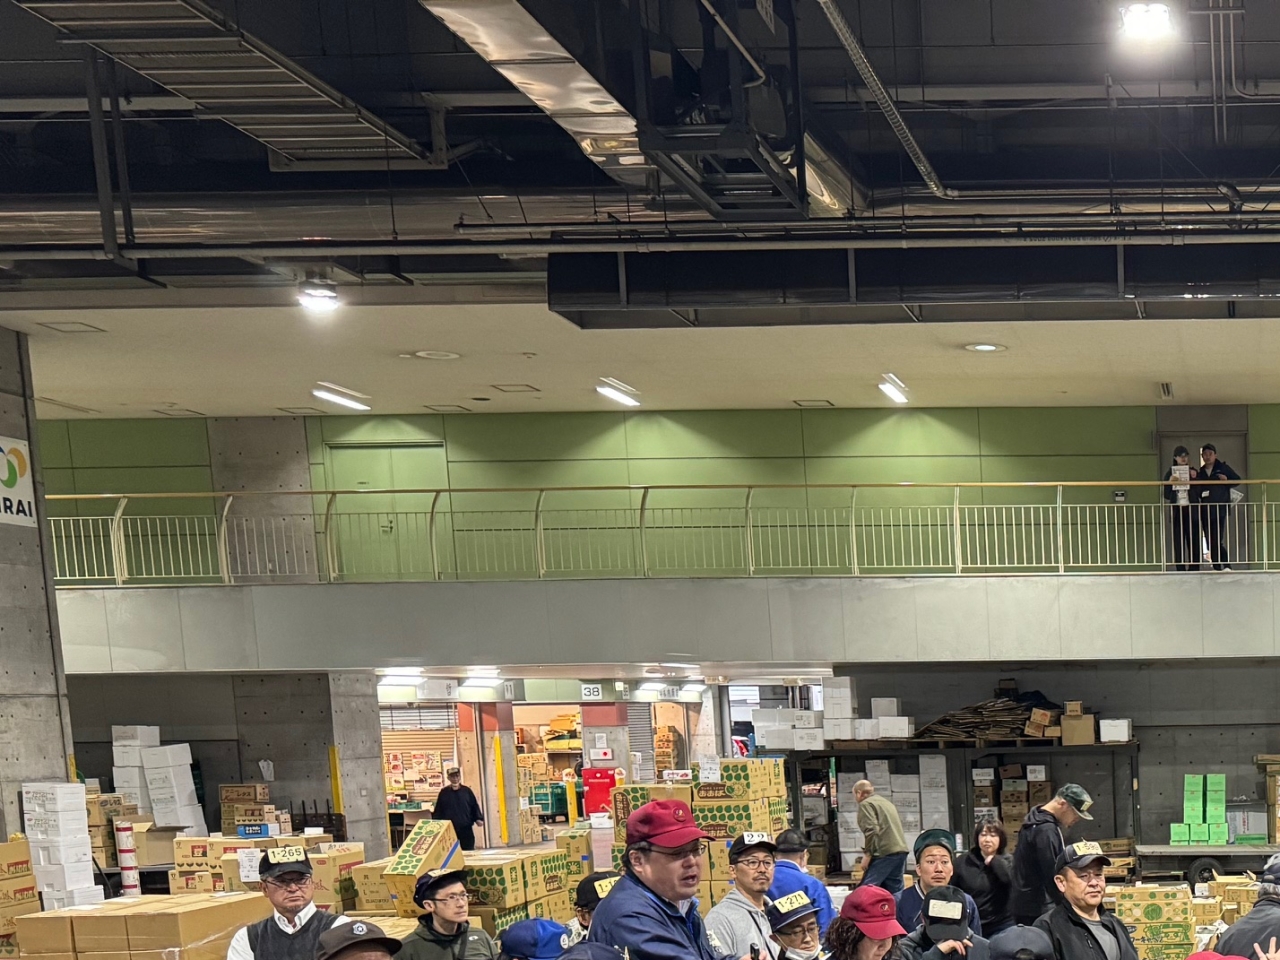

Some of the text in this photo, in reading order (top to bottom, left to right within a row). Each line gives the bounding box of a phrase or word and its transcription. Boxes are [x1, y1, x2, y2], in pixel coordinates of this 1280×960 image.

[0, 496, 33, 518] RAI
[583, 686, 600, 697] 38
[271, 847, 302, 859] 1-265
[777, 892, 805, 908] 1-271
